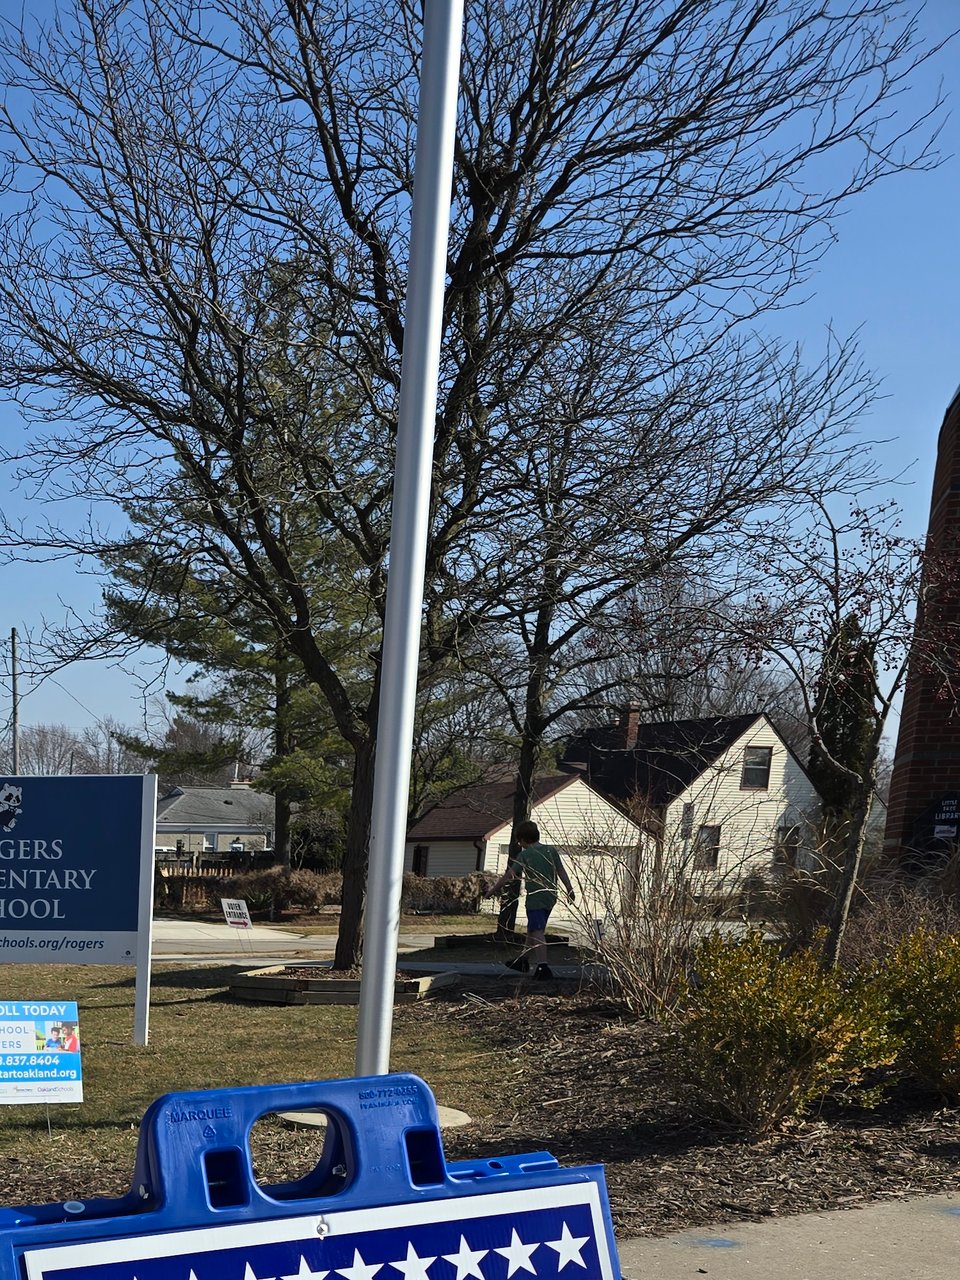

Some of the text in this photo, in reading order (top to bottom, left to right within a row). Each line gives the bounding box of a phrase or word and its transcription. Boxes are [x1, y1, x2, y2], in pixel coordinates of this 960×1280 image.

[935, 812, 960, 820] LIBRAR
[225, 910, 249, 920] ENTRANCE
[22, 1005, 67, 1016] TODAY
[170, 1106, 233, 1123] MARQUEE
